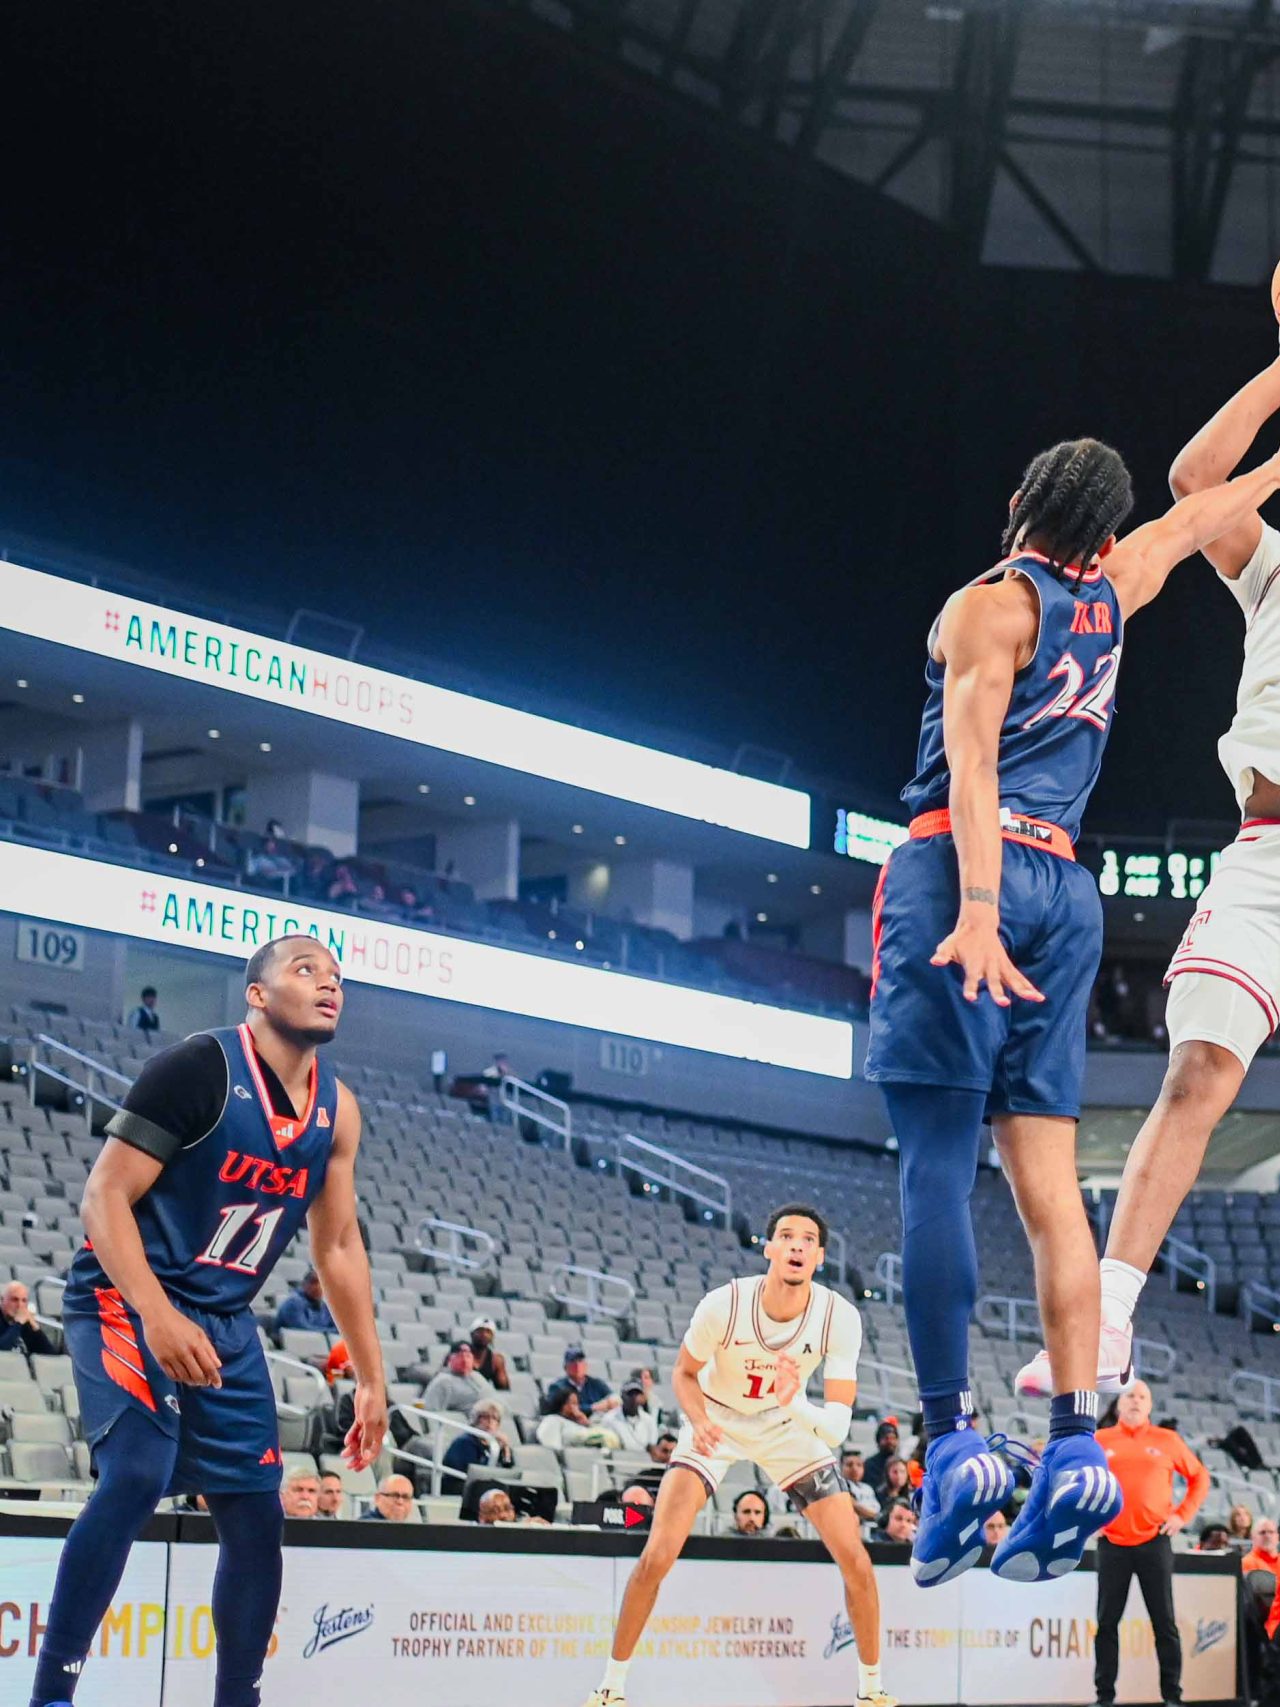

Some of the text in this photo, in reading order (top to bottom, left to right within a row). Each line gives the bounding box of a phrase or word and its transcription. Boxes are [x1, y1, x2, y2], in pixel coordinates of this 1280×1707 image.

[104, 609, 415, 725] #AMERICANHOOPS
[1022, 652, 1119, 732] 22
[30, 929, 77, 964] 109
[219, 1150, 308, 1199] UTSA
[195, 1203, 285, 1275] 11
[409, 1612, 477, 1632] OFFICIAL
[483, 1613, 514, 1633] AND
[704, 1615, 763, 1634] JEWELRY
[768, 1616, 794, 1634] AND
[887, 1629, 910, 1648] THE
[392, 1638, 451, 1657] TROPHY
[456, 1638, 525, 1657] PARTNER
[529, 1639, 547, 1657] OF
[724, 1640, 807, 1658] CONFERENCE
